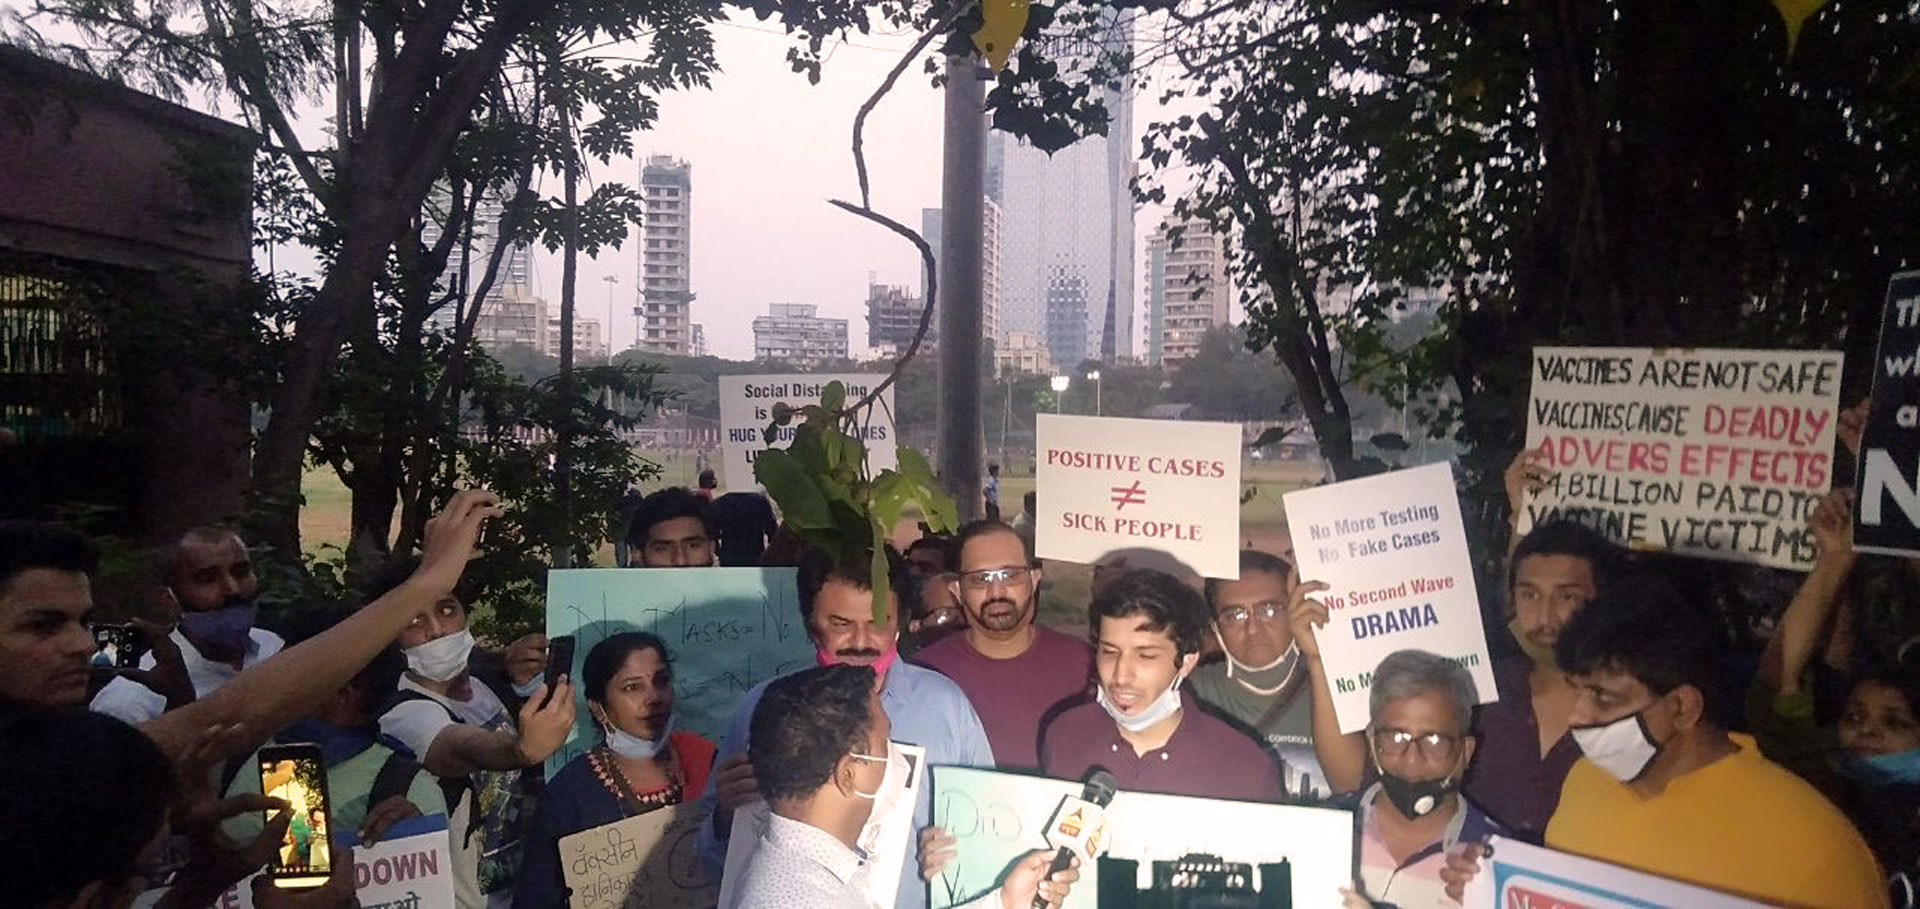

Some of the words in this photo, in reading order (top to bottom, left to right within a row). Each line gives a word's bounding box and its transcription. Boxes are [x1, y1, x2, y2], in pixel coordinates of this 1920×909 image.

[744, 384, 788, 399] Social
[793, 383, 867, 400] Disting
[1538, 355, 1632, 385] VACCINES
[1638, 359, 1700, 389] ARE
[1703, 361, 1759, 392] NOT
[1757, 361, 1838, 396] SAFE
[754, 406, 767, 420] is
[1703, 404, 1830, 446] DEADLY
[729, 428, 756, 442] HUG
[761, 427, 798, 442] YUR
[1048, 449, 1141, 472] POSITIVE
[1147, 457, 1226, 478] CASES
[1535, 435, 1671, 474] ADVERS
[1680, 444, 1829, 488] EFFECTS
[1696, 482, 1784, 517] PAID
[1062, 511, 1107, 532] SICK
[1114, 518, 1202, 541] PEOPLE
[1309, 524, 1331, 541] No
[1334, 517, 1377, 536] More
[1379, 504, 1440, 528] Testing
[1660, 517, 1819, 563] VICTIMS
[1318, 547, 1340, 564] No
[1348, 539, 1388, 558] Fake
[1391, 529, 1441, 551] Cases
[1324, 595, 1345, 611] No
[1348, 583, 1407, 607] Second
[1410, 576, 1455, 595] Wave
[1351, 603, 1439, 639] DRAMA
[1335, 677, 1356, 694] No
